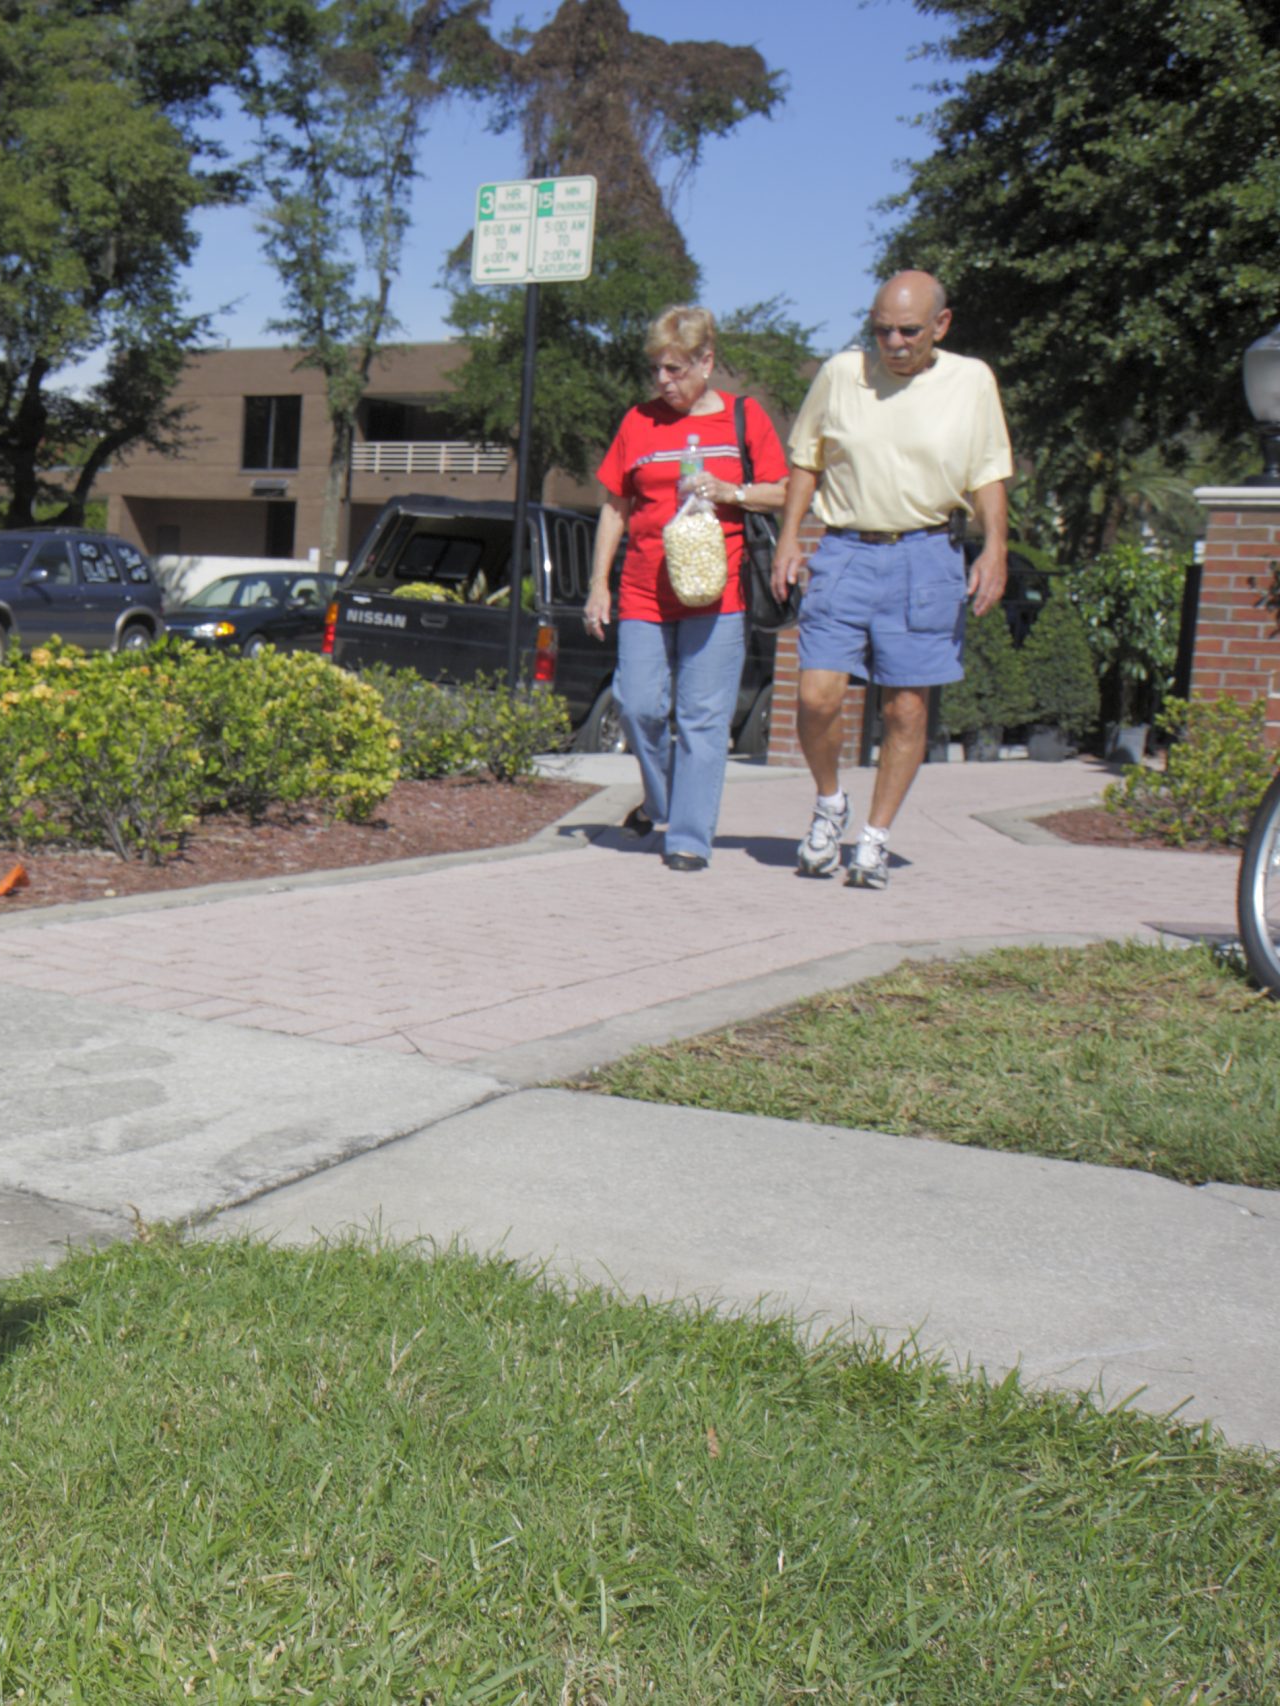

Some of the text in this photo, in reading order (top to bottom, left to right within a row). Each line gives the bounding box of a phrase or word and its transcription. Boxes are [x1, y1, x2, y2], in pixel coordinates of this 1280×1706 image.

[480, 188, 521, 214] 3 HR
[498, 202, 528, 211] PARKING
[538, 193, 553, 209] 15
[556, 201, 589, 211] PARKING
[508, 223, 522, 234] AM
[571, 220, 586, 231] AM
[495, 238, 508, 250] TO
[558, 234, 570, 247] TO
[506, 251, 519, 261] PM
[567, 249, 581, 259] PM
[537, 263, 583, 274] SATURDAY
[346, 608, 407, 628] NISSAN
